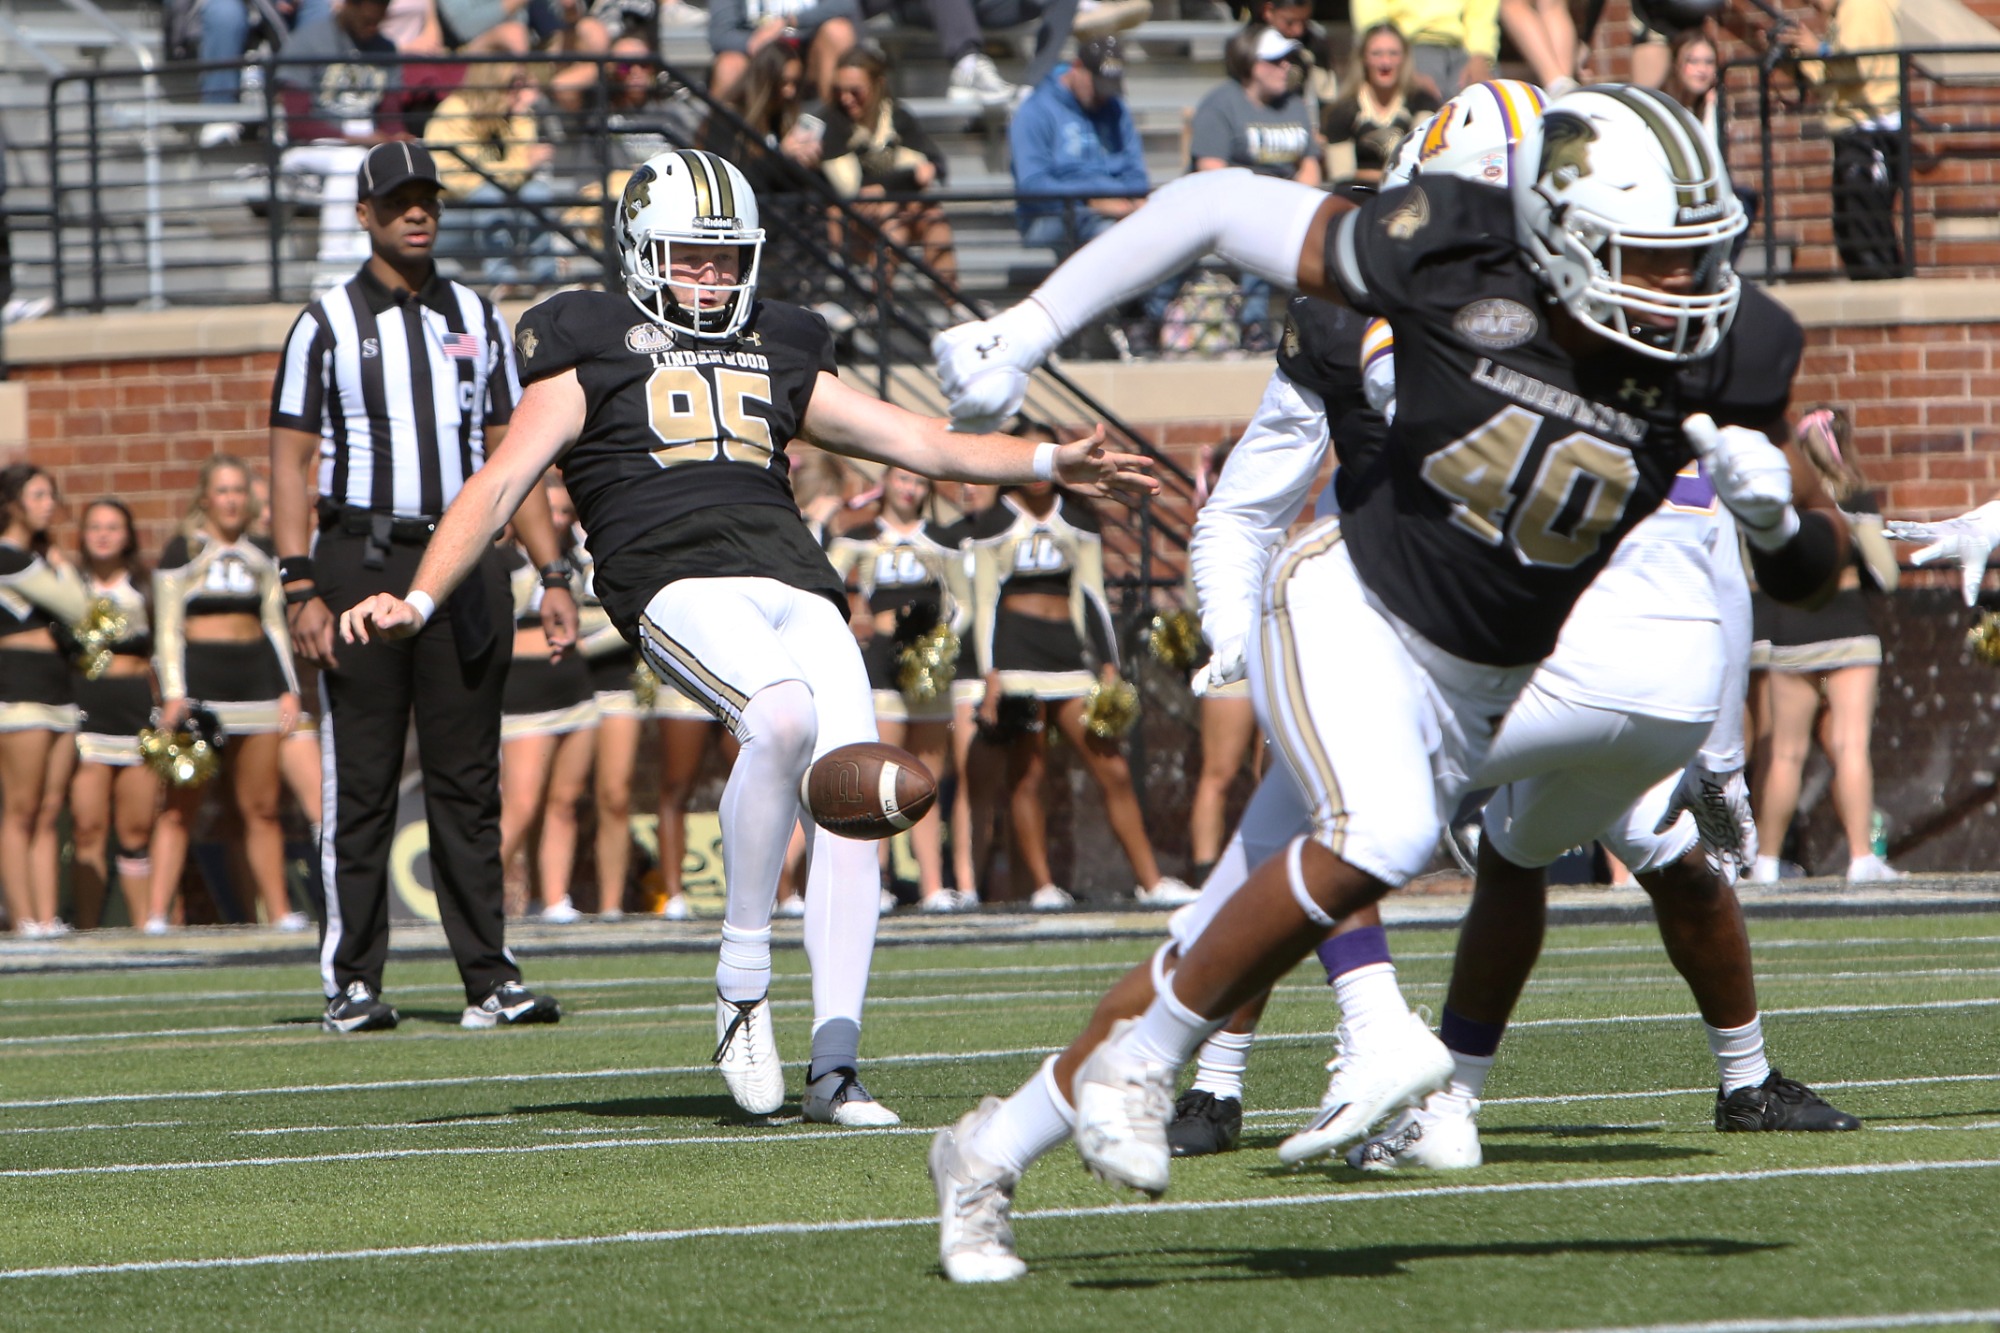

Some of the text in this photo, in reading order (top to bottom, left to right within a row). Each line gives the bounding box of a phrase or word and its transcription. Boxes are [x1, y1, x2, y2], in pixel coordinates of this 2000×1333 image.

[703, 218, 732, 227] Riddell
[650, 350, 770, 371] LINDENWOOD
[645, 366, 774, 469] 95
[1419, 404, 1640, 570] 40
